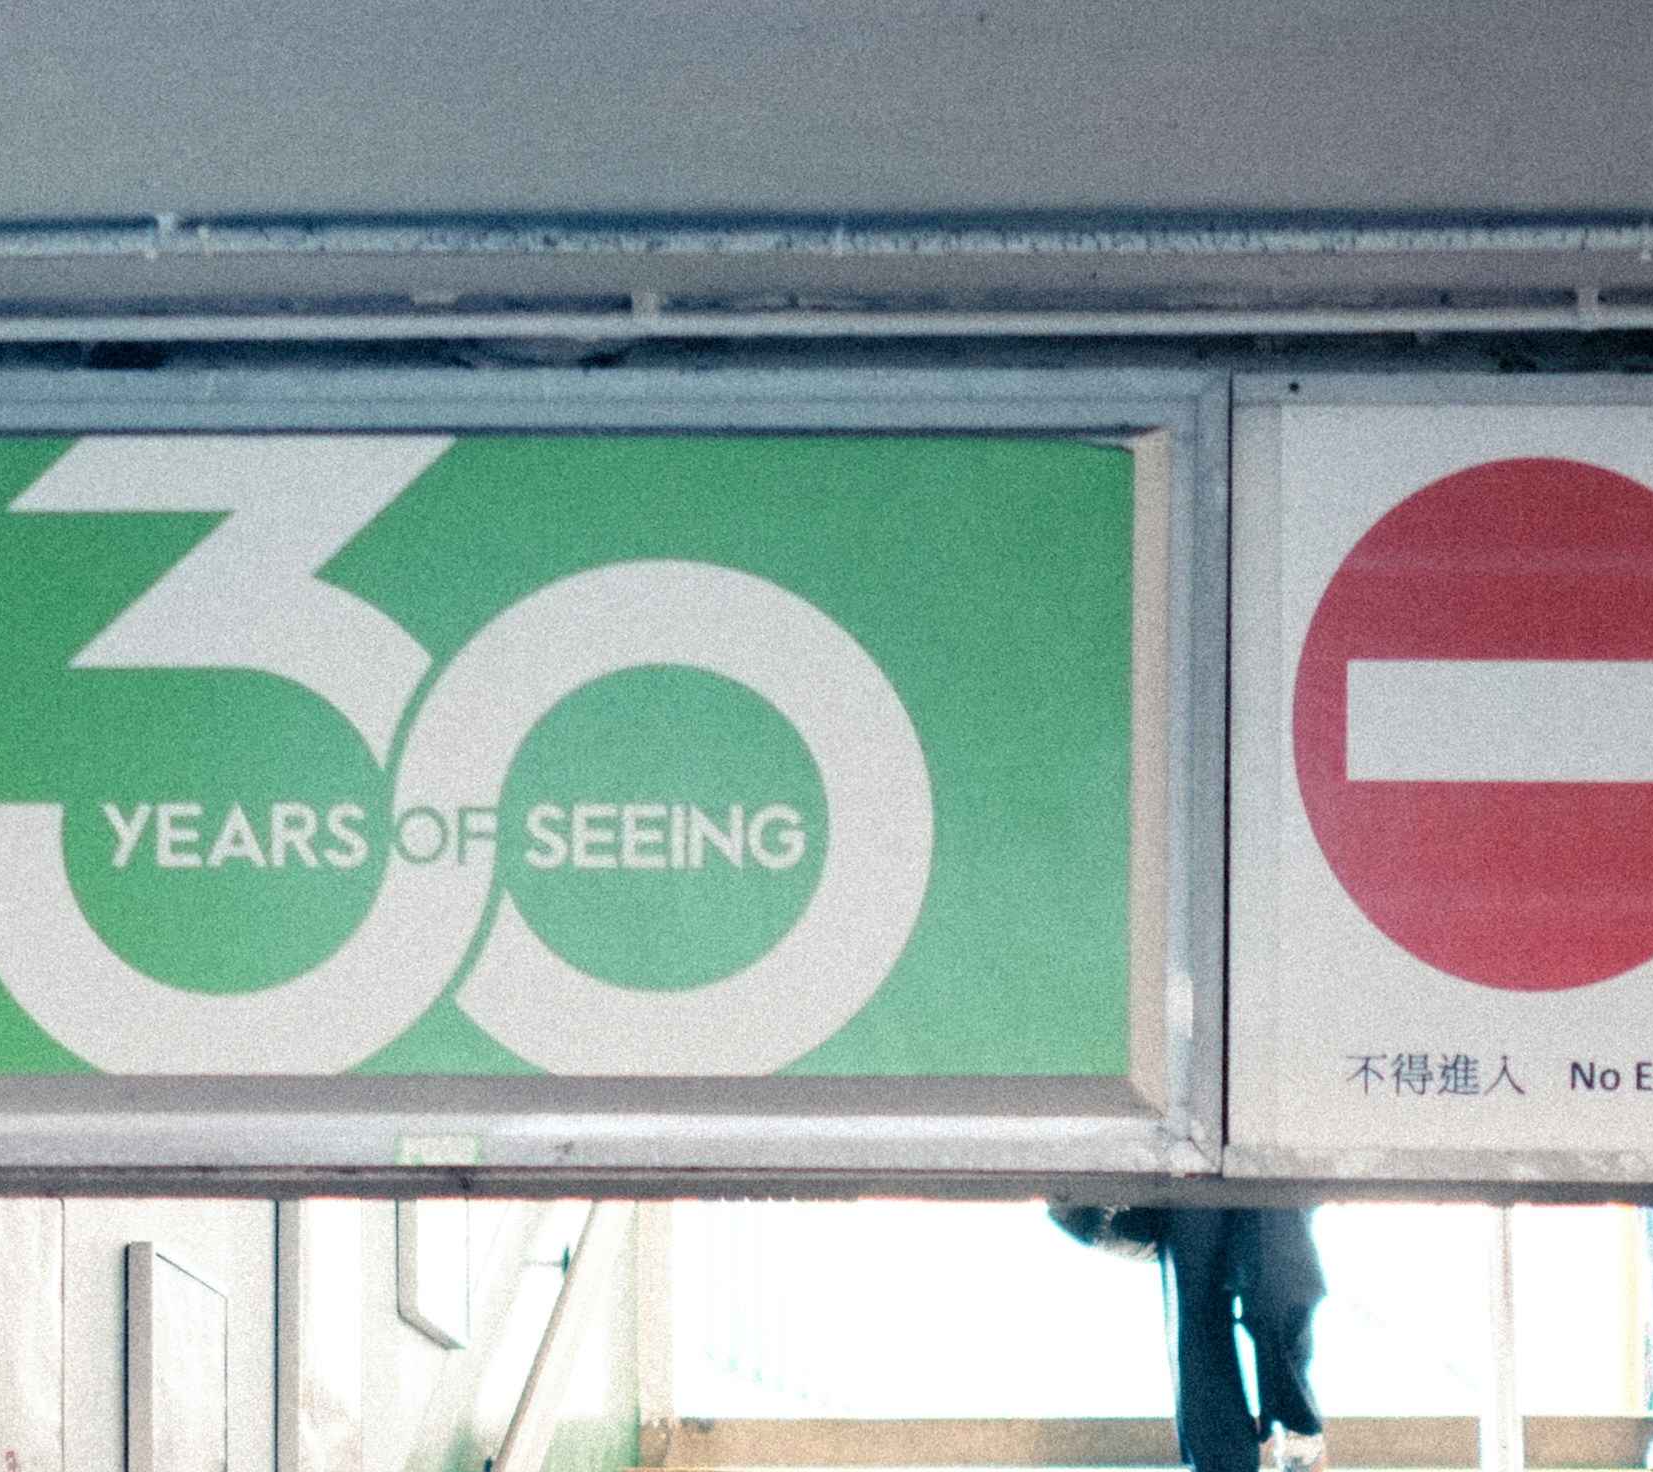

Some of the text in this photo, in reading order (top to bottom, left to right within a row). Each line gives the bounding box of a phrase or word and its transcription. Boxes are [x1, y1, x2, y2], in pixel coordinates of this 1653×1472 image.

[103, 803, 807, 869] YEARS OF SEEING
[1345, 1053, 1527, 1096] 不得進入
[1569, 1061, 1622, 1092] No
